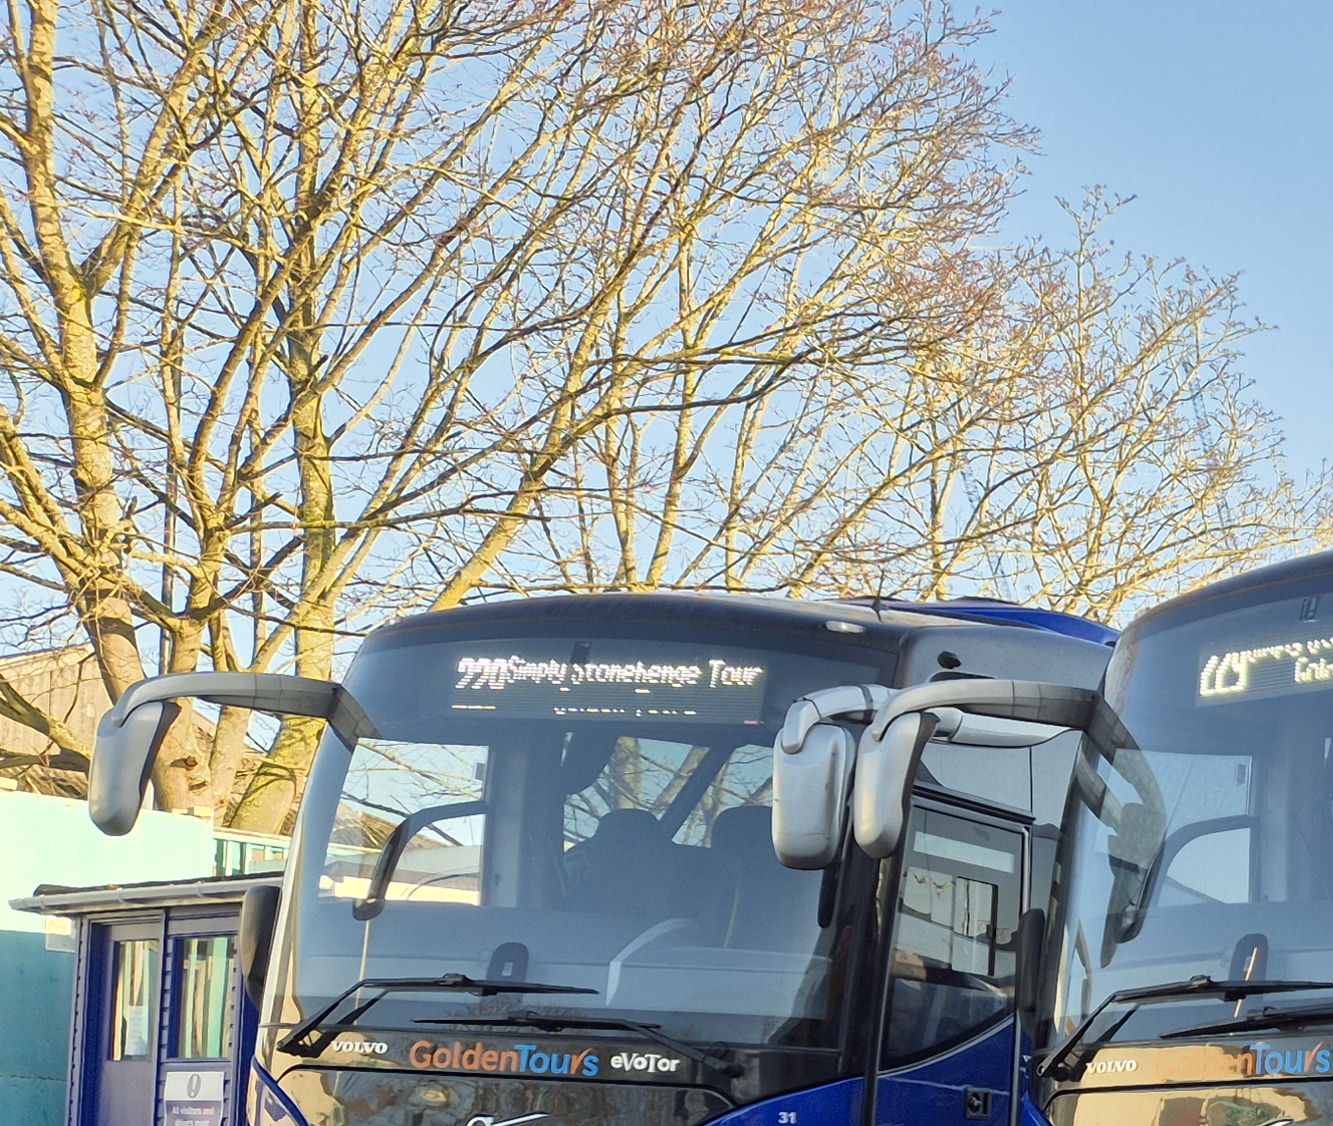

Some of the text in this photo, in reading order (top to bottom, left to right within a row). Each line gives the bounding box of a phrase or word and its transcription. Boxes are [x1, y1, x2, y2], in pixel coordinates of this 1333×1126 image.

[330, 1040, 388, 1055] VOLVO
[1086, 1059, 1138, 1074] VOLVO
[778, 1111, 797, 1124] 31
